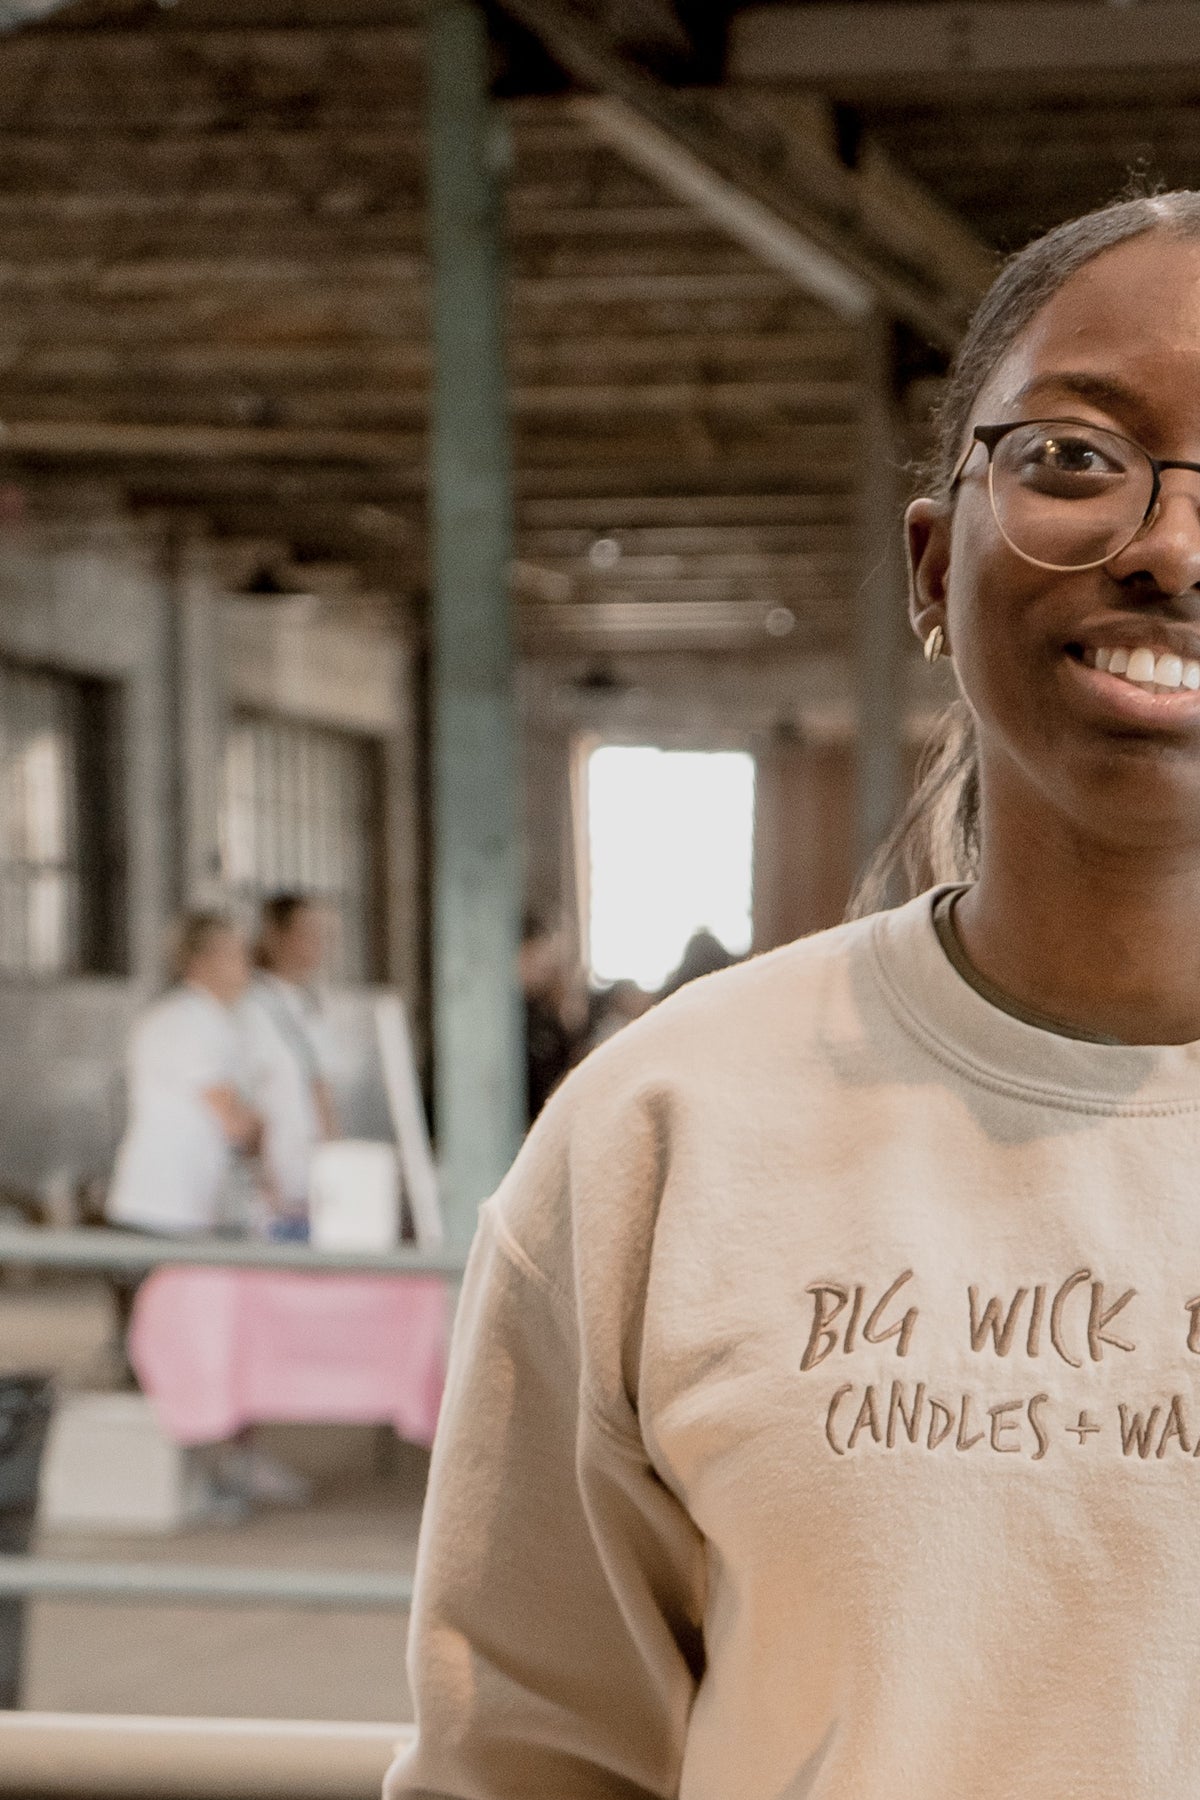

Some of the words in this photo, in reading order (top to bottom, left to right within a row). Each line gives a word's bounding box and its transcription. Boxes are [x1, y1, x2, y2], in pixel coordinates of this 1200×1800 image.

[800, 1270, 918, 1371] BIG
[968, 1270, 1138, 1367] WICK
[826, 1381, 1049, 1460] CANDLES
